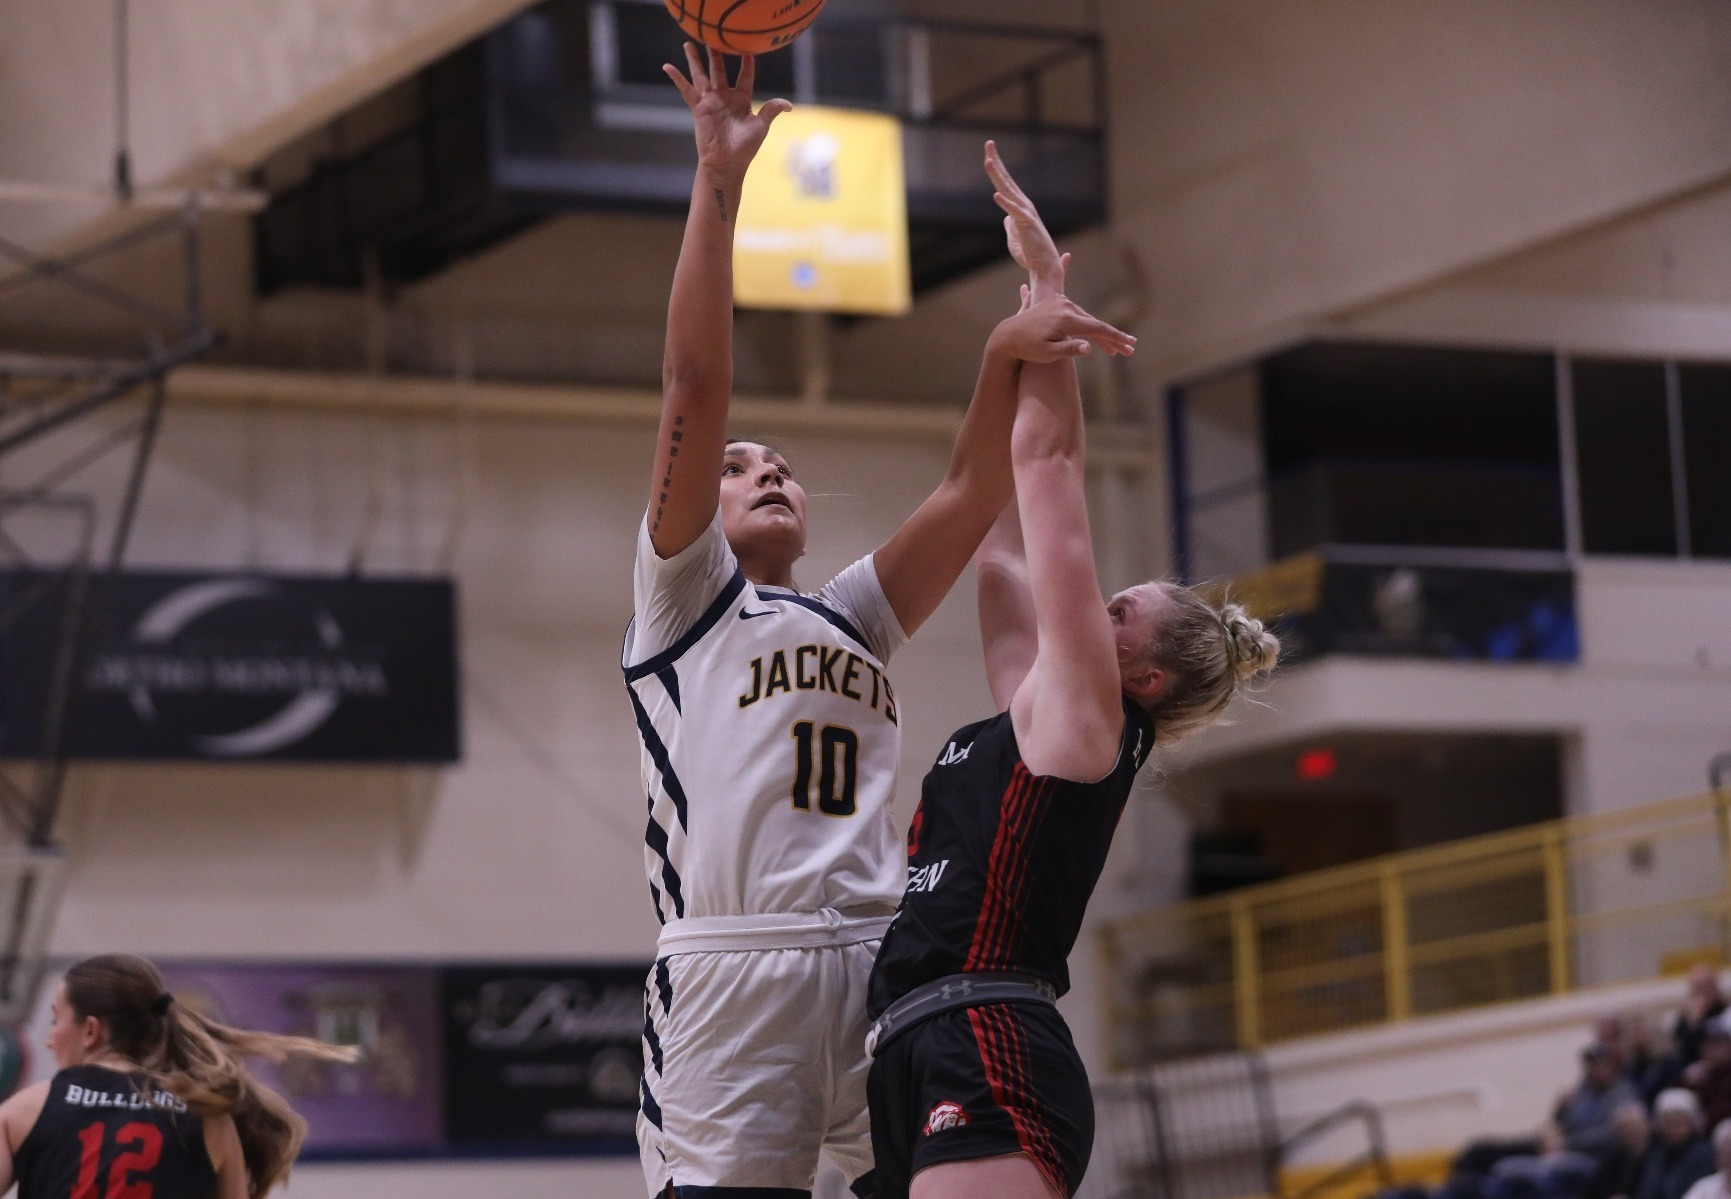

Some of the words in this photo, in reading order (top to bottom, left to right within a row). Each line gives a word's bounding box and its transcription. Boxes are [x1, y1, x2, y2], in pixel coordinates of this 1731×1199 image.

[738, 645, 898, 728] JACKETS
[790, 719, 859, 818] 10
[70, 1121, 163, 1199] 12
